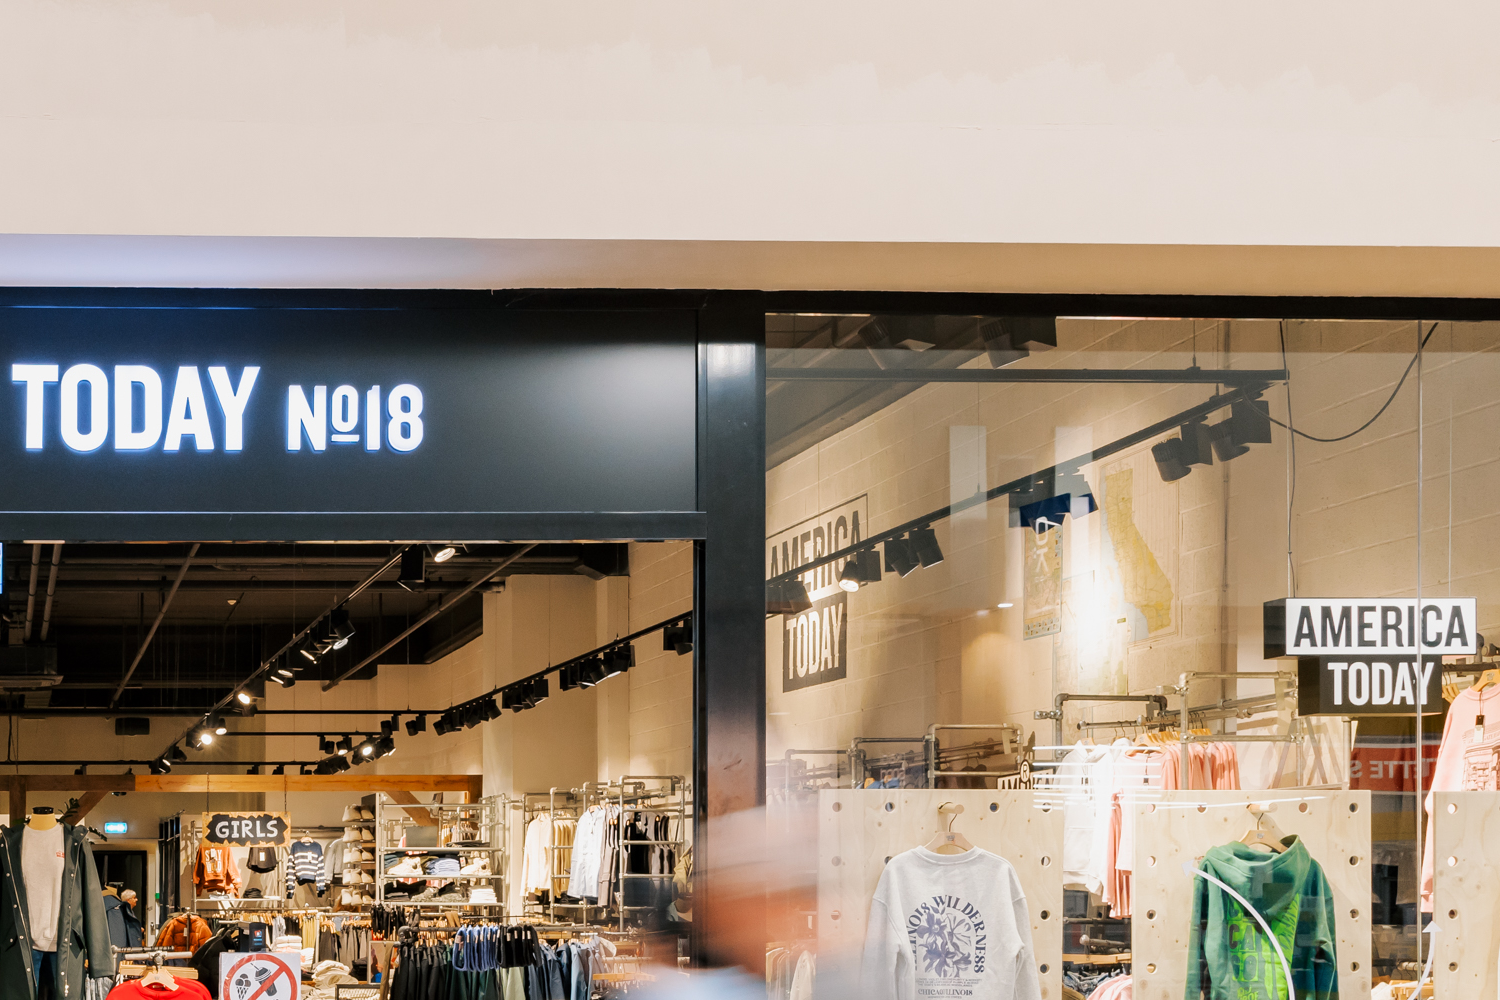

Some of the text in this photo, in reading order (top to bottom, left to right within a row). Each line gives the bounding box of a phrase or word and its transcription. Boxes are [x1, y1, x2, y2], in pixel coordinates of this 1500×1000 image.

[11, 363, 261, 452] TODAY
[786, 602, 844, 680] TODAY
[1293, 605, 1469, 648] AMERICA
[1327, 662, 1435, 706] TODAY
[215, 820, 279, 839] GIRLS
[931, 894, 987, 974] WILDERNESS
